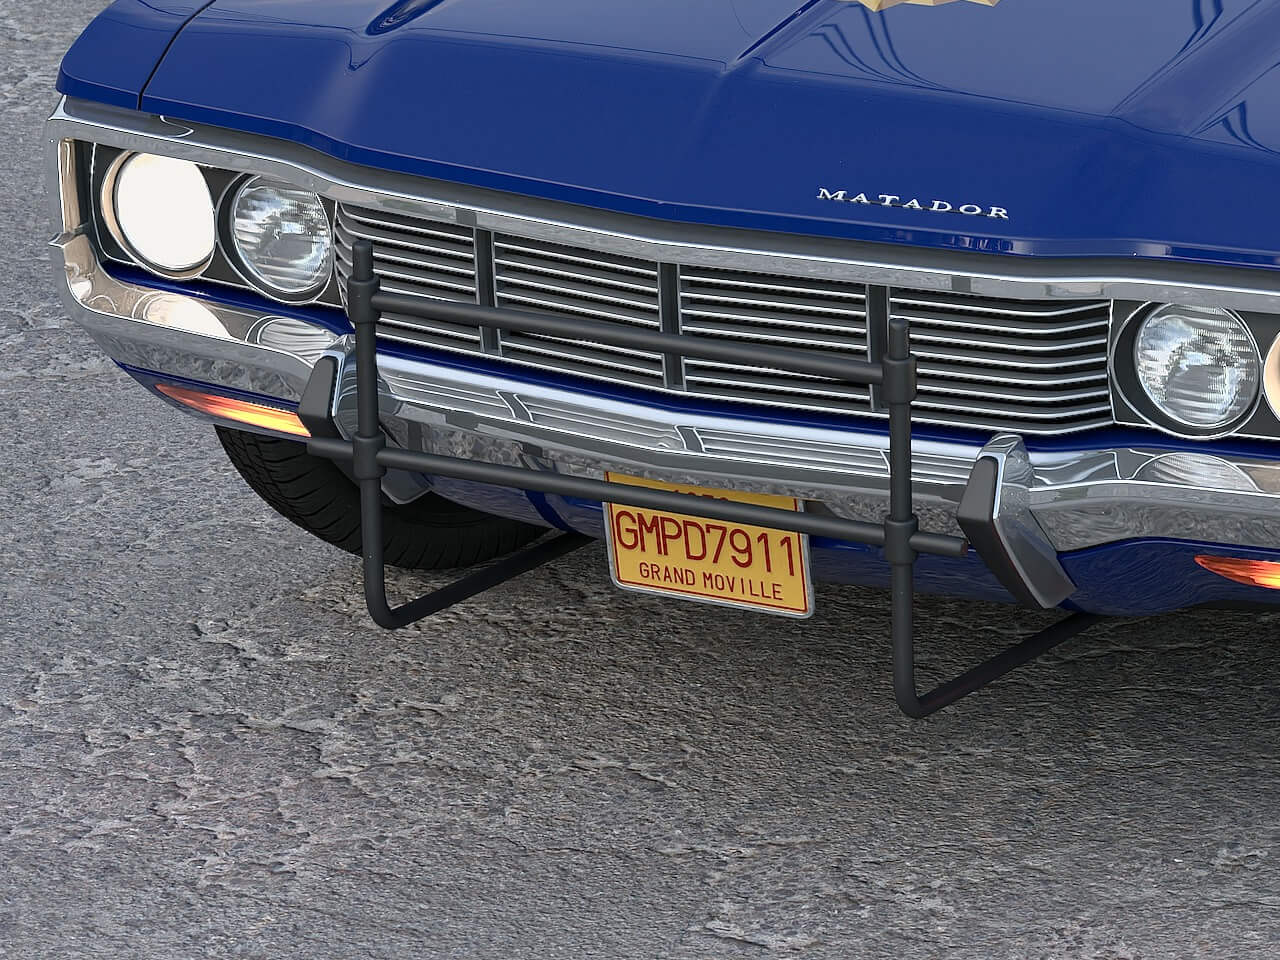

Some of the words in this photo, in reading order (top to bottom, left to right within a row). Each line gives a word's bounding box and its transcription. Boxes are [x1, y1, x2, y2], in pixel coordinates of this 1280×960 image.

[816, 187, 1009, 220] MATADOR
[615, 509, 795, 577] GMPD7911
[639, 561, 696, 586] GRAND
[702, 571, 783, 601] MOVILLE
